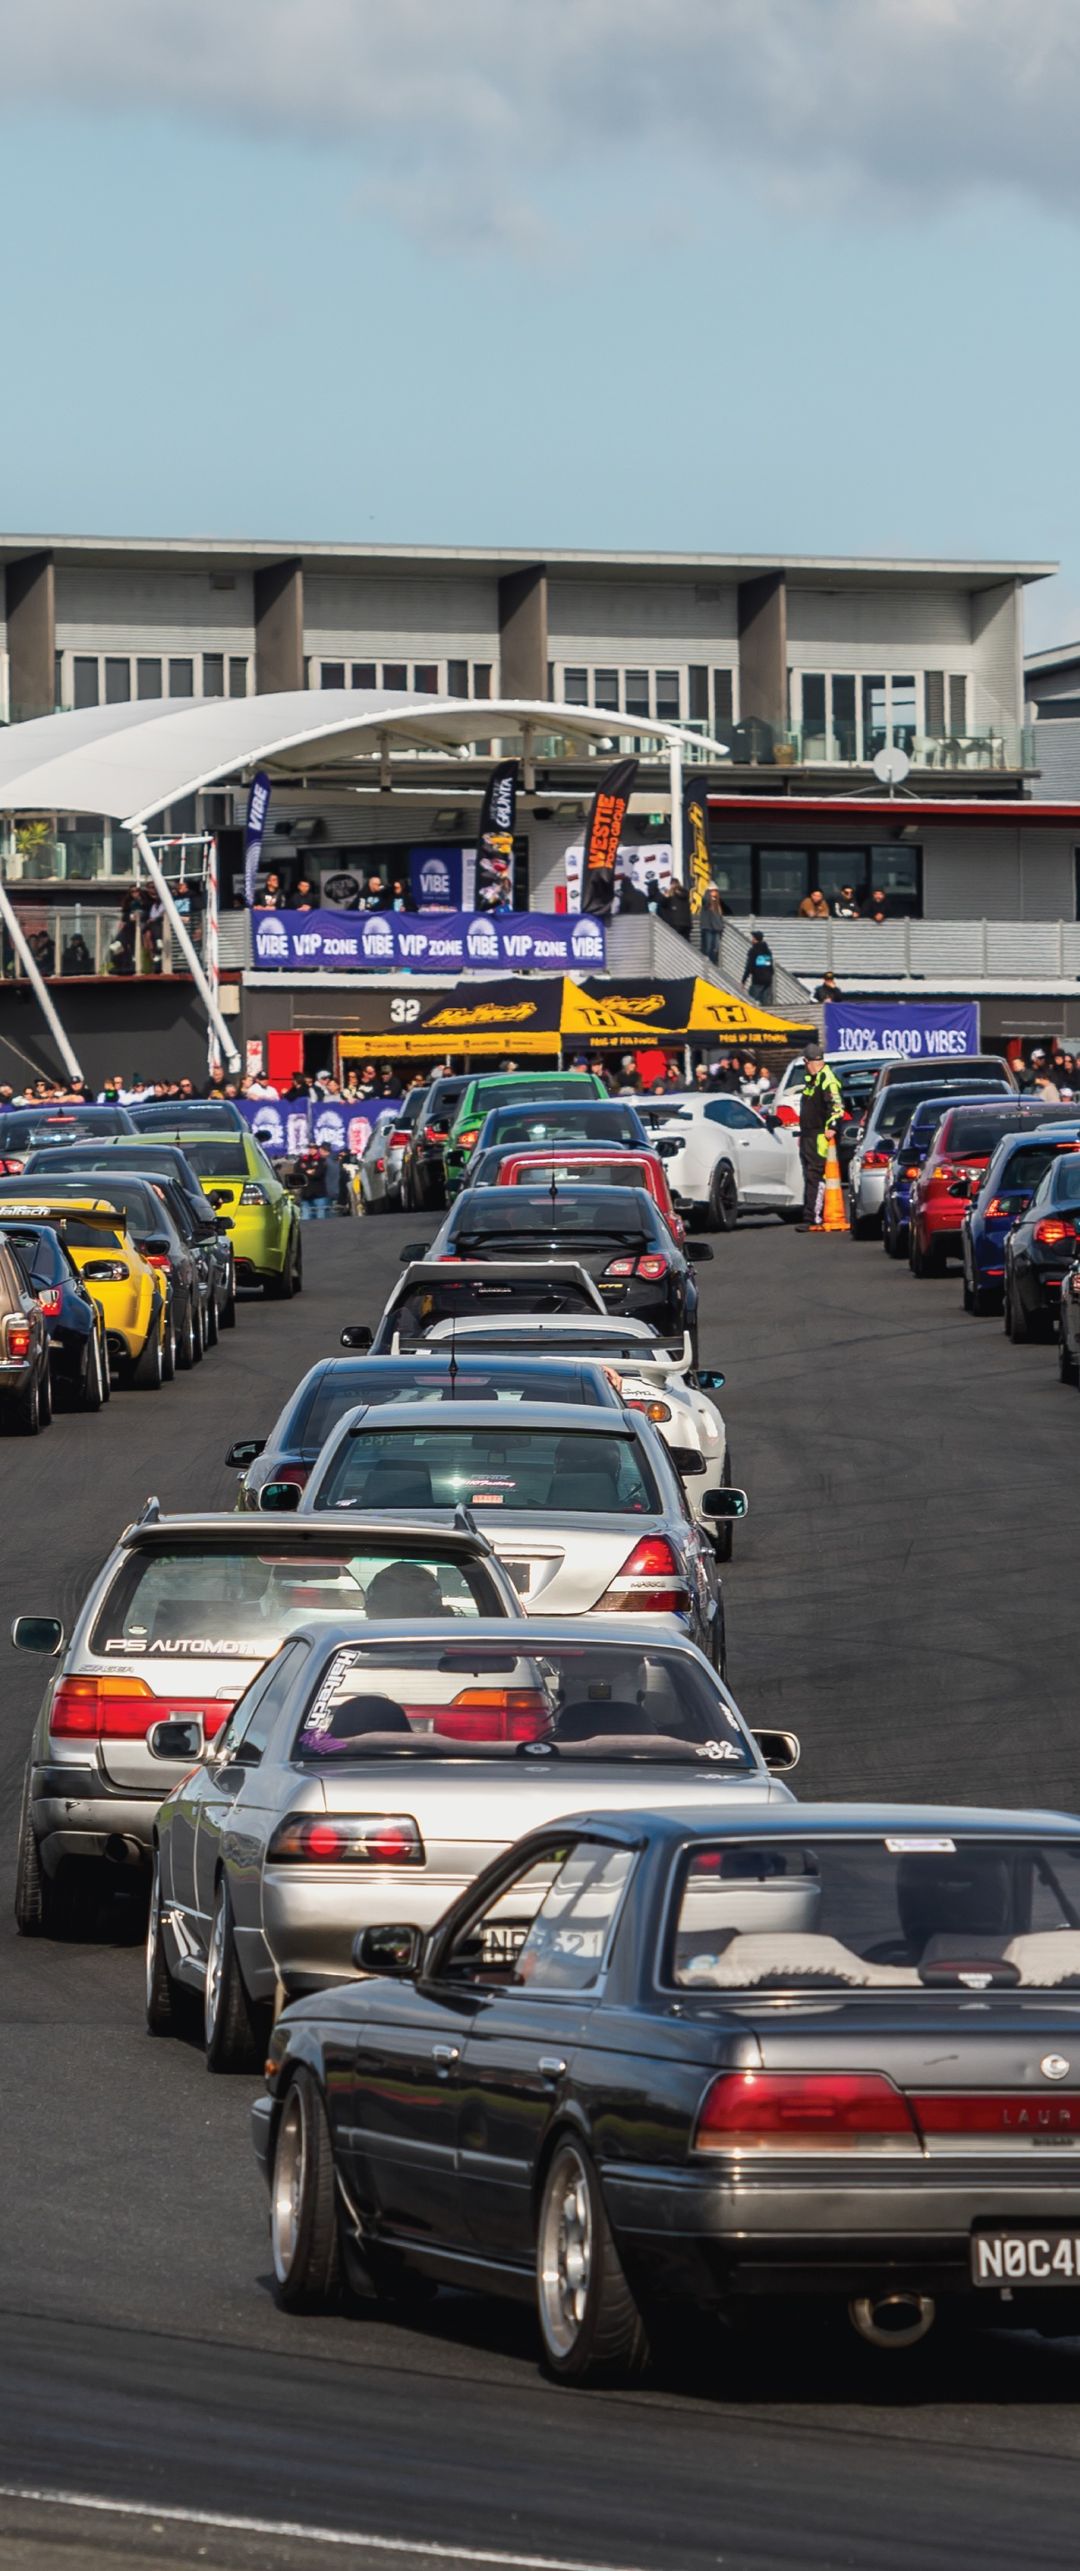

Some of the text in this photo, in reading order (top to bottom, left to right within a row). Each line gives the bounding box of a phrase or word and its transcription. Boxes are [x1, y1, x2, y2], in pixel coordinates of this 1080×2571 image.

[248, 784, 268, 831] VIBE
[588, 793, 616, 870] WESTIE
[605, 798, 626, 869] FOOD GROUP
[420, 874, 449, 892] VIBE
[256, 933, 603, 957] VIBE VIP ZONE VIBE VIP ZONE VIBE VIP ZONE VIBE
[390, 998, 421, 1024] 32
[837, 1027, 968, 1054] 100% GOOD VIBES
[105, 1639, 147, 1652] PS
[304, 1649, 361, 1729] Haltech
[705, 1740, 740, 1760] 32
